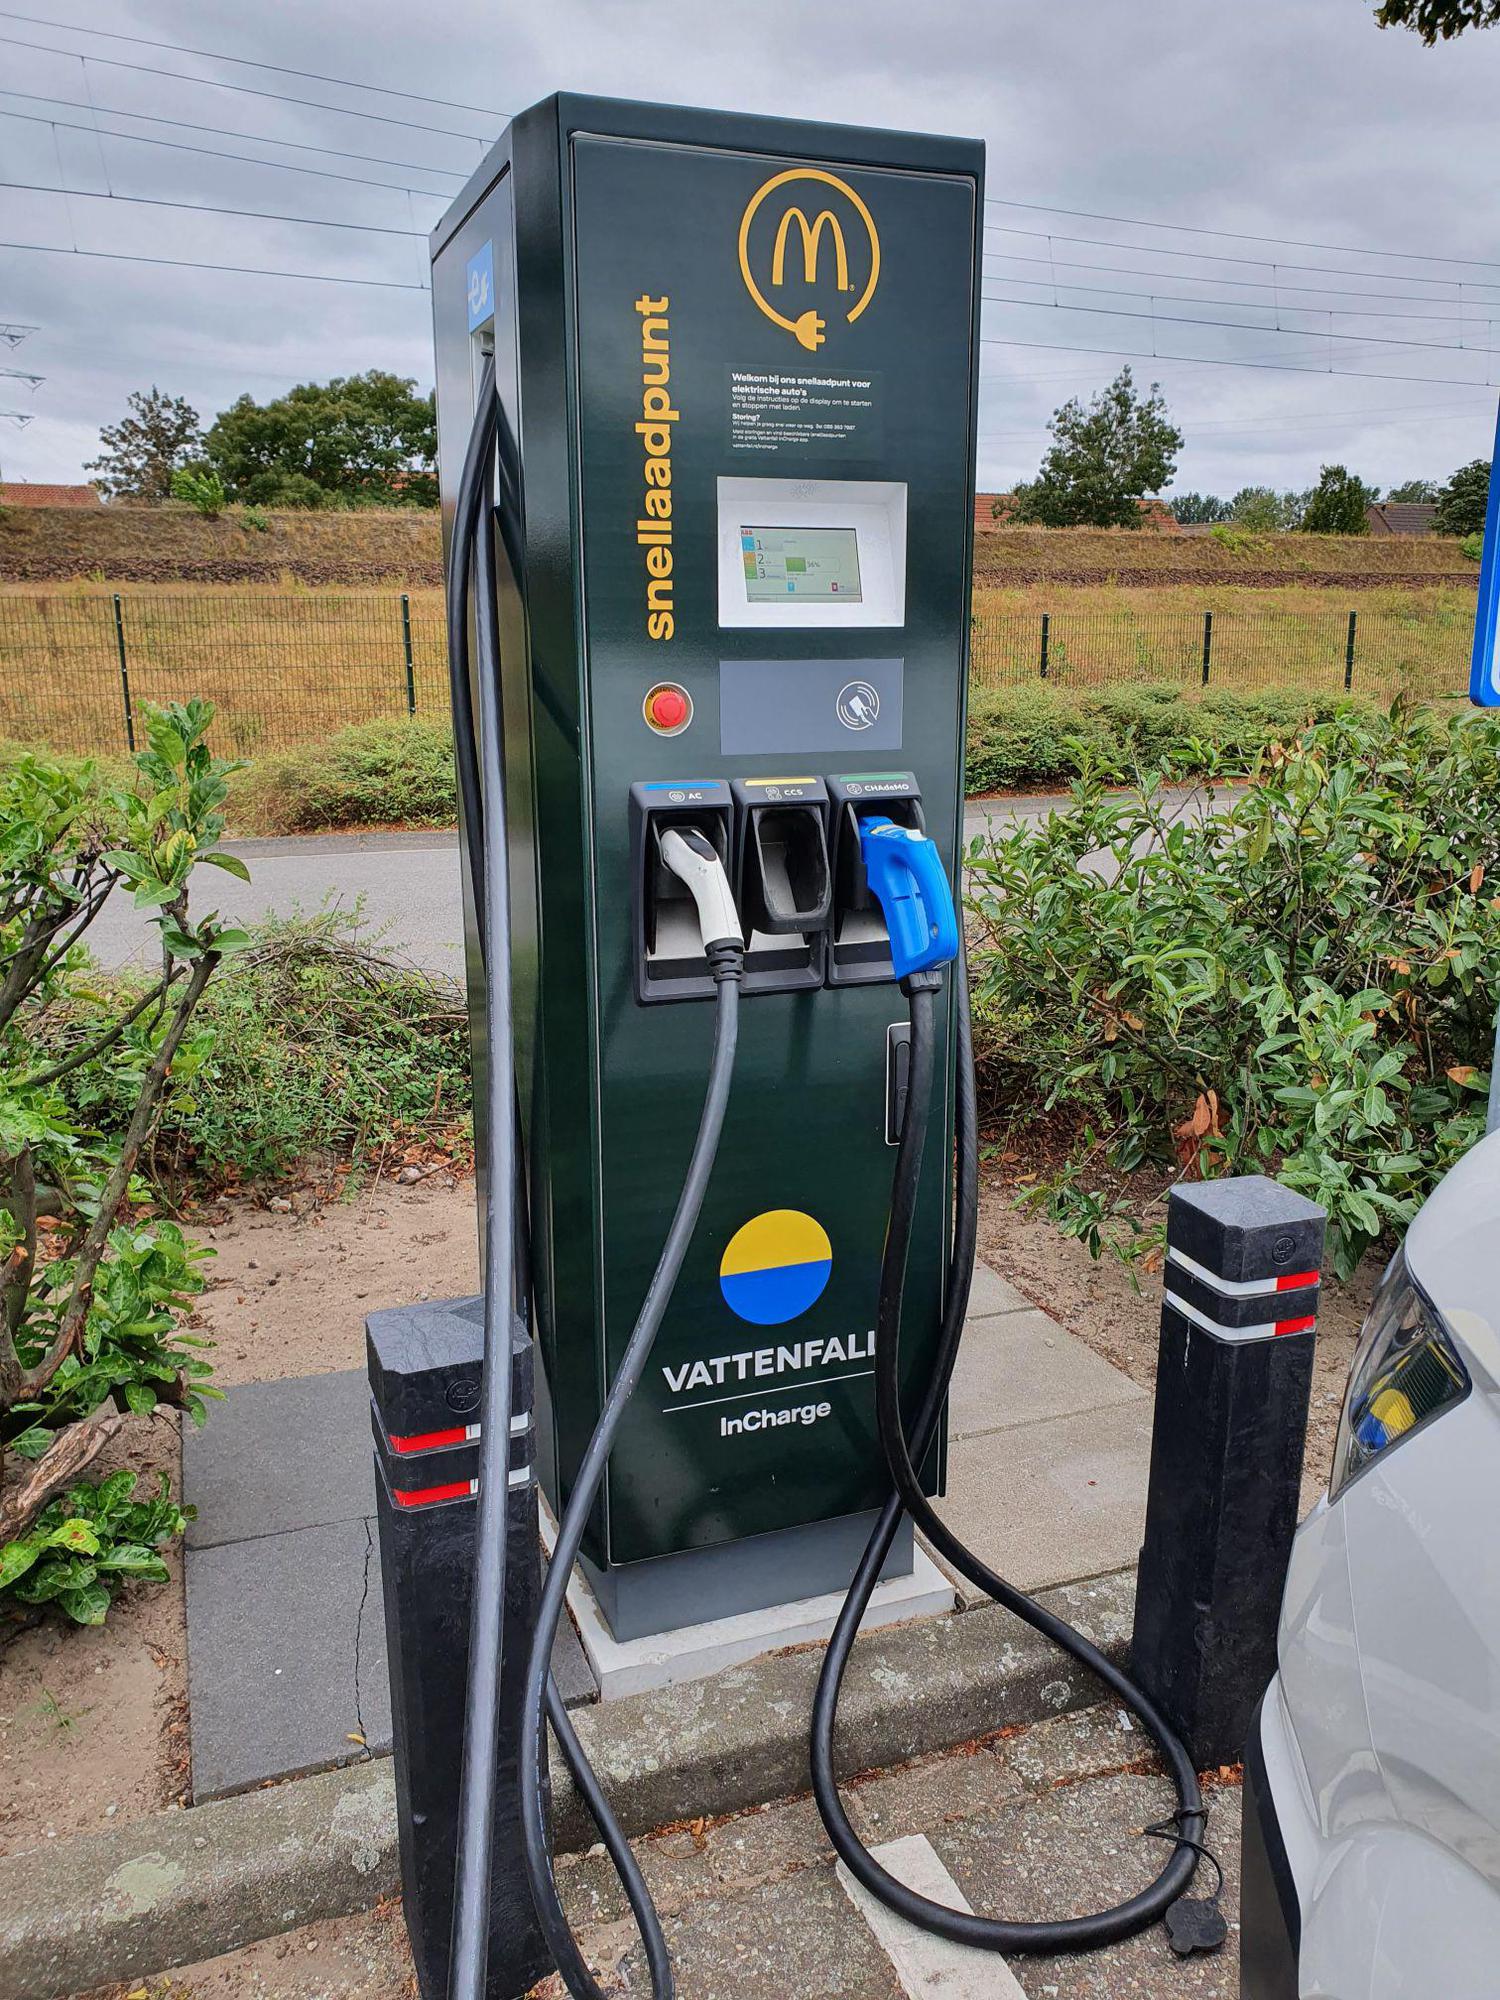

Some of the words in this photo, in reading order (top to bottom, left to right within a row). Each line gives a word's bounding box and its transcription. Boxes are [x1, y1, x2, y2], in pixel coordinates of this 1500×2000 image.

[732, 373, 768, 383] Welkom
[769, 375, 780, 385] bij
[797, 378, 850, 388] snellaadpunt
[851, 380, 871, 388] voor
[732, 385, 780, 395] elektrische
[781, 388, 807, 396] auto's
[732, 394, 747, 402] Volg
[809, 398, 831, 406] display
[732, 413, 760, 422] Storing?
[635, 295, 680, 641] snellaadpunt
[756, 539, 763, 550] 1
[757, 553, 765, 565] 2
[759, 567, 766, 579] 3
[784, 789, 803, 797] CCS
[864, 783, 909, 792] CHAdeMO
[688, 792, 703, 800] AC
[720, 1401, 832, 1437] InCharge
